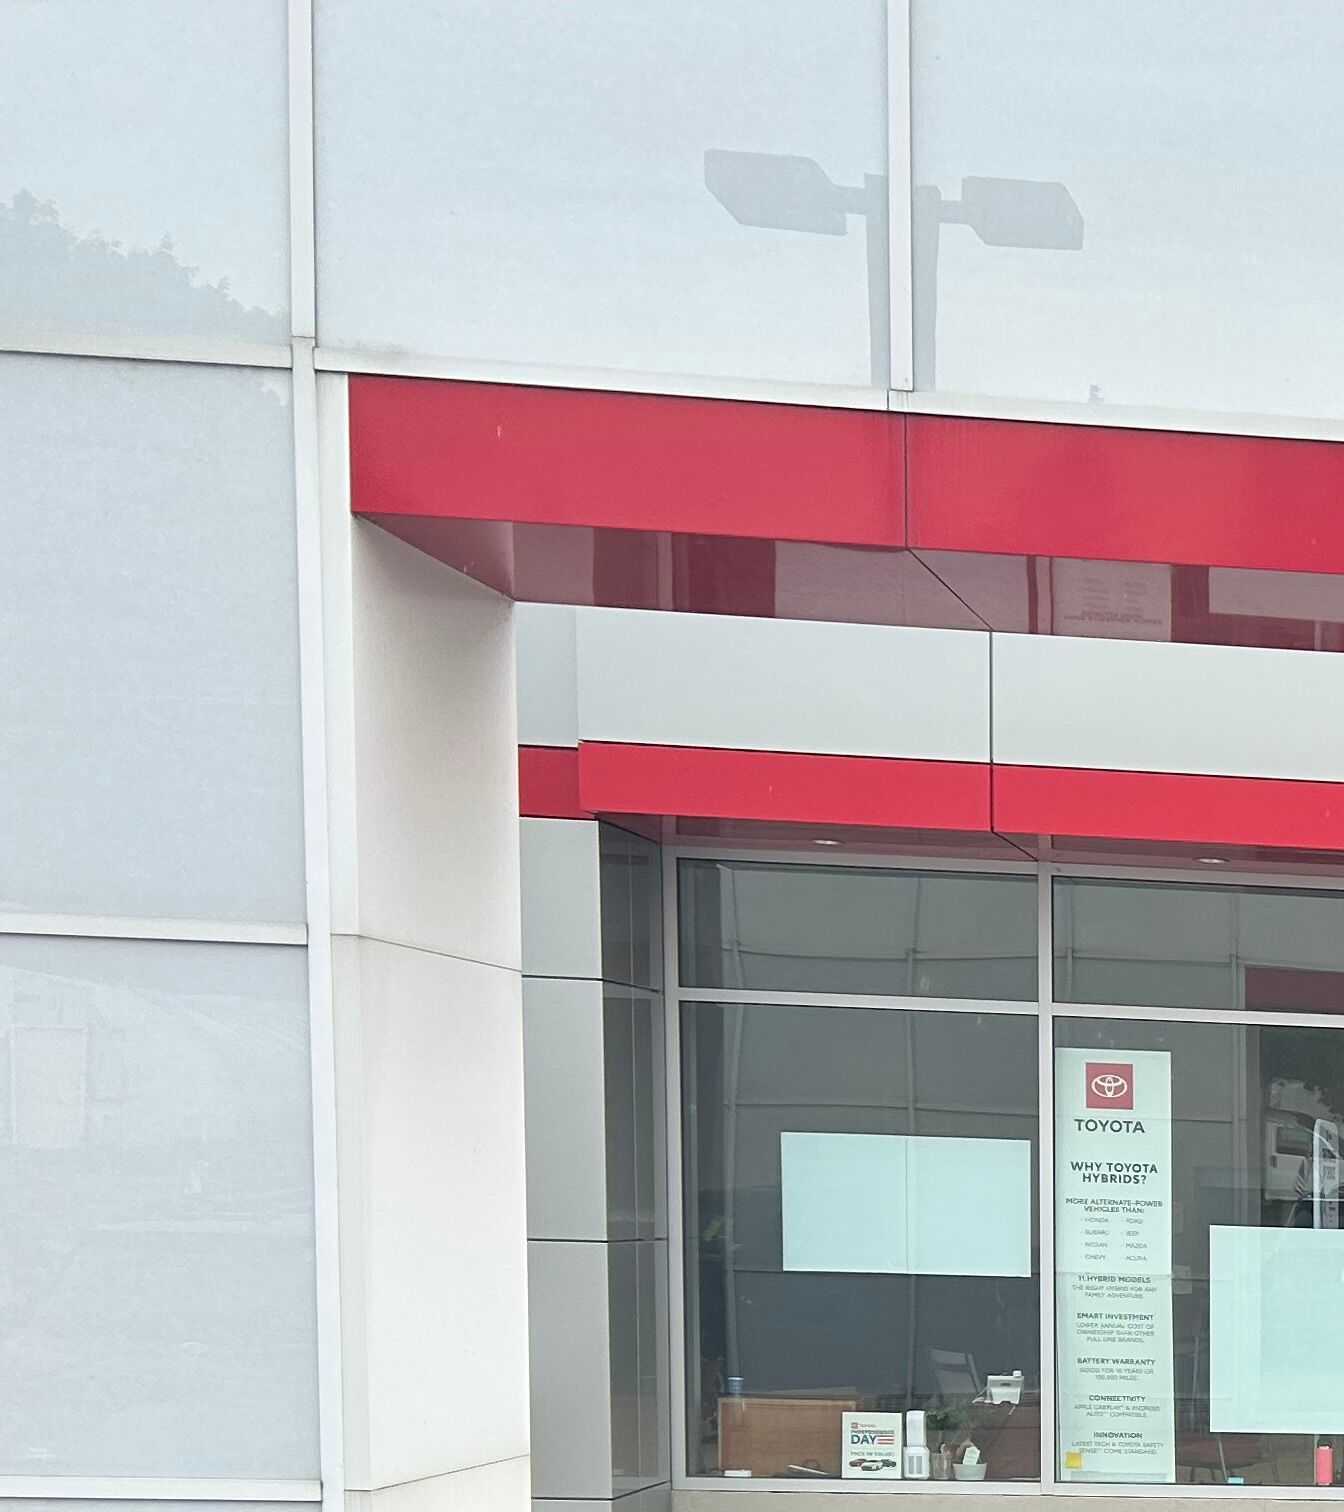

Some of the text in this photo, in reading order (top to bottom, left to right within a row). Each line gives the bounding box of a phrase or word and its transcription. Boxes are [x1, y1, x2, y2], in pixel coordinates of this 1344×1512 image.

[1074, 1119, 1145, 1133] TOYOTA
[1071, 1161, 1158, 1173] WHY TOYOTA
[1083, 1174, 1147, 1184] HYBRIDS?
[851, 1434, 877, 1445] DAY
